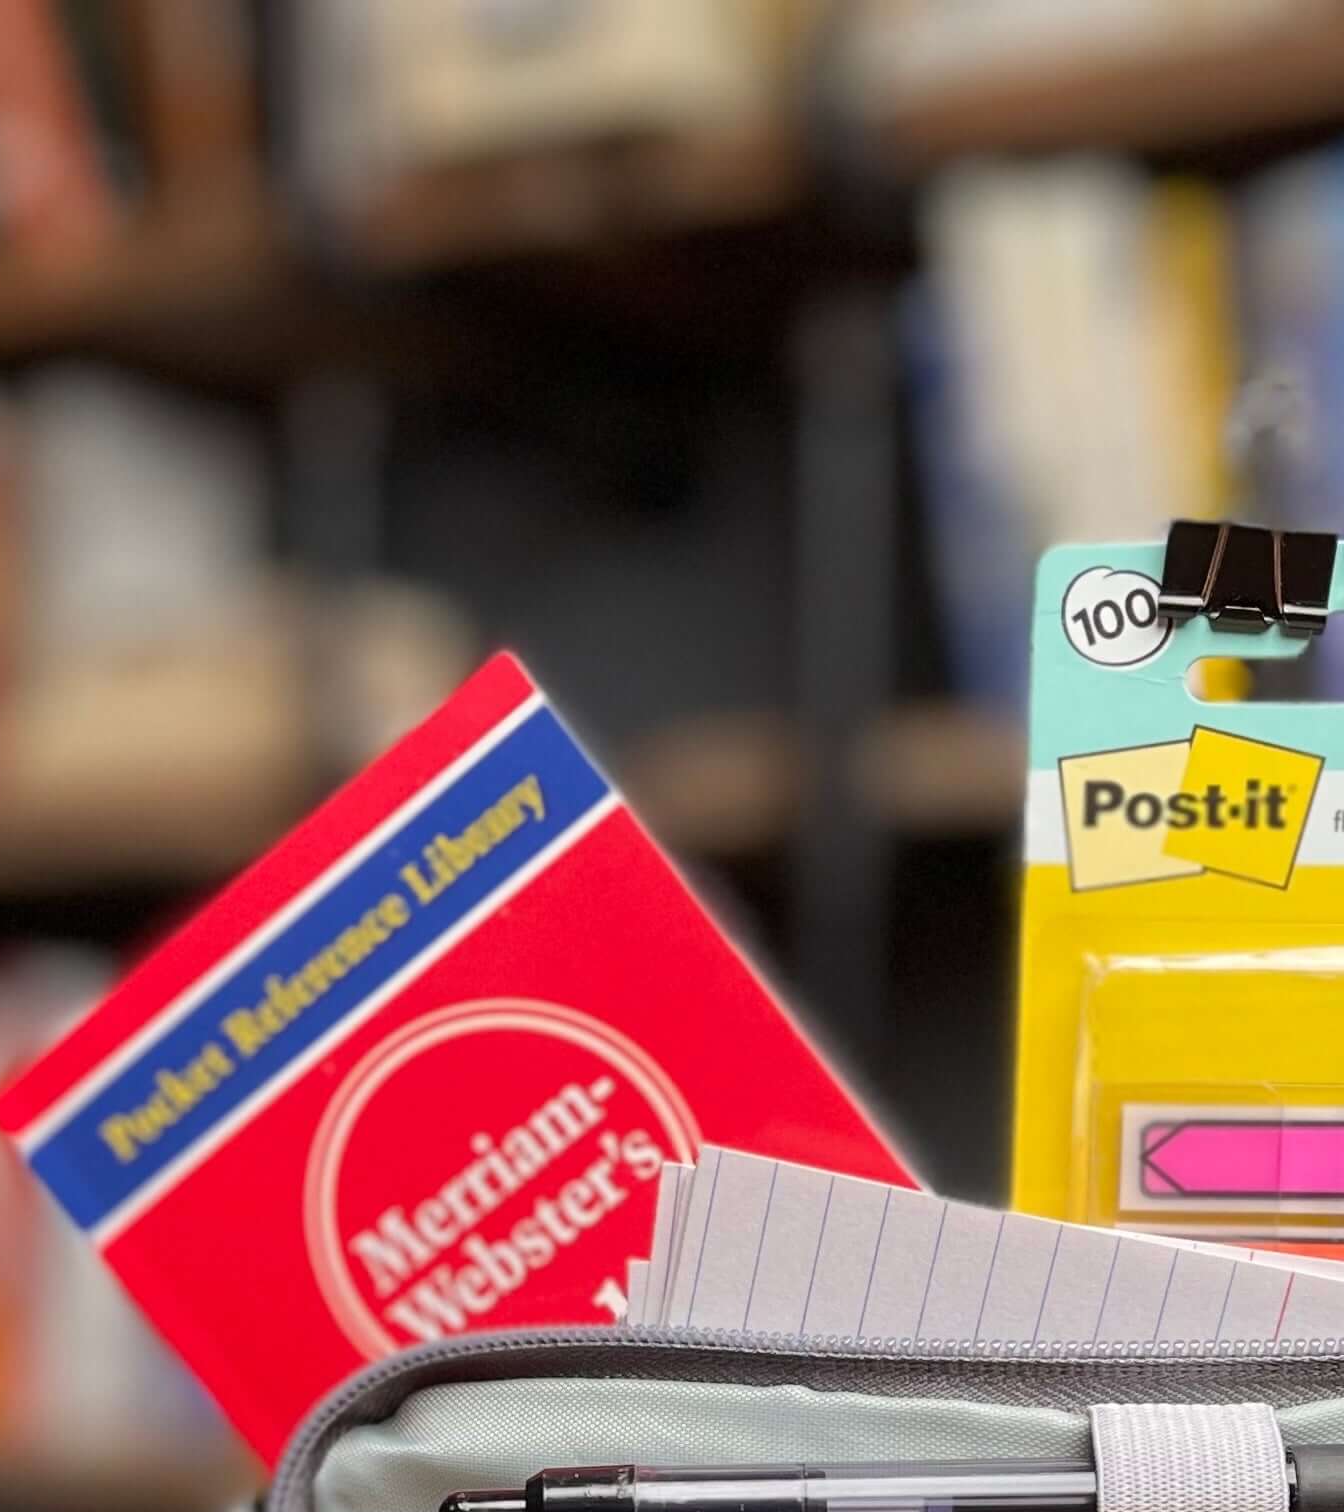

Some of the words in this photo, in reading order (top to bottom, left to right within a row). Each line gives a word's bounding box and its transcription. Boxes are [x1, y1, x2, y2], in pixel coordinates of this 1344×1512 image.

[1071, 587, 1157, 648] 100
[101, 1043, 233, 1161] Pocket
[225, 895, 410, 1059] Reference
[402, 775, 545, 905] Library
[351, 1076, 615, 1295] Merriam-
[386, 1129, 660, 1342] Webster's
